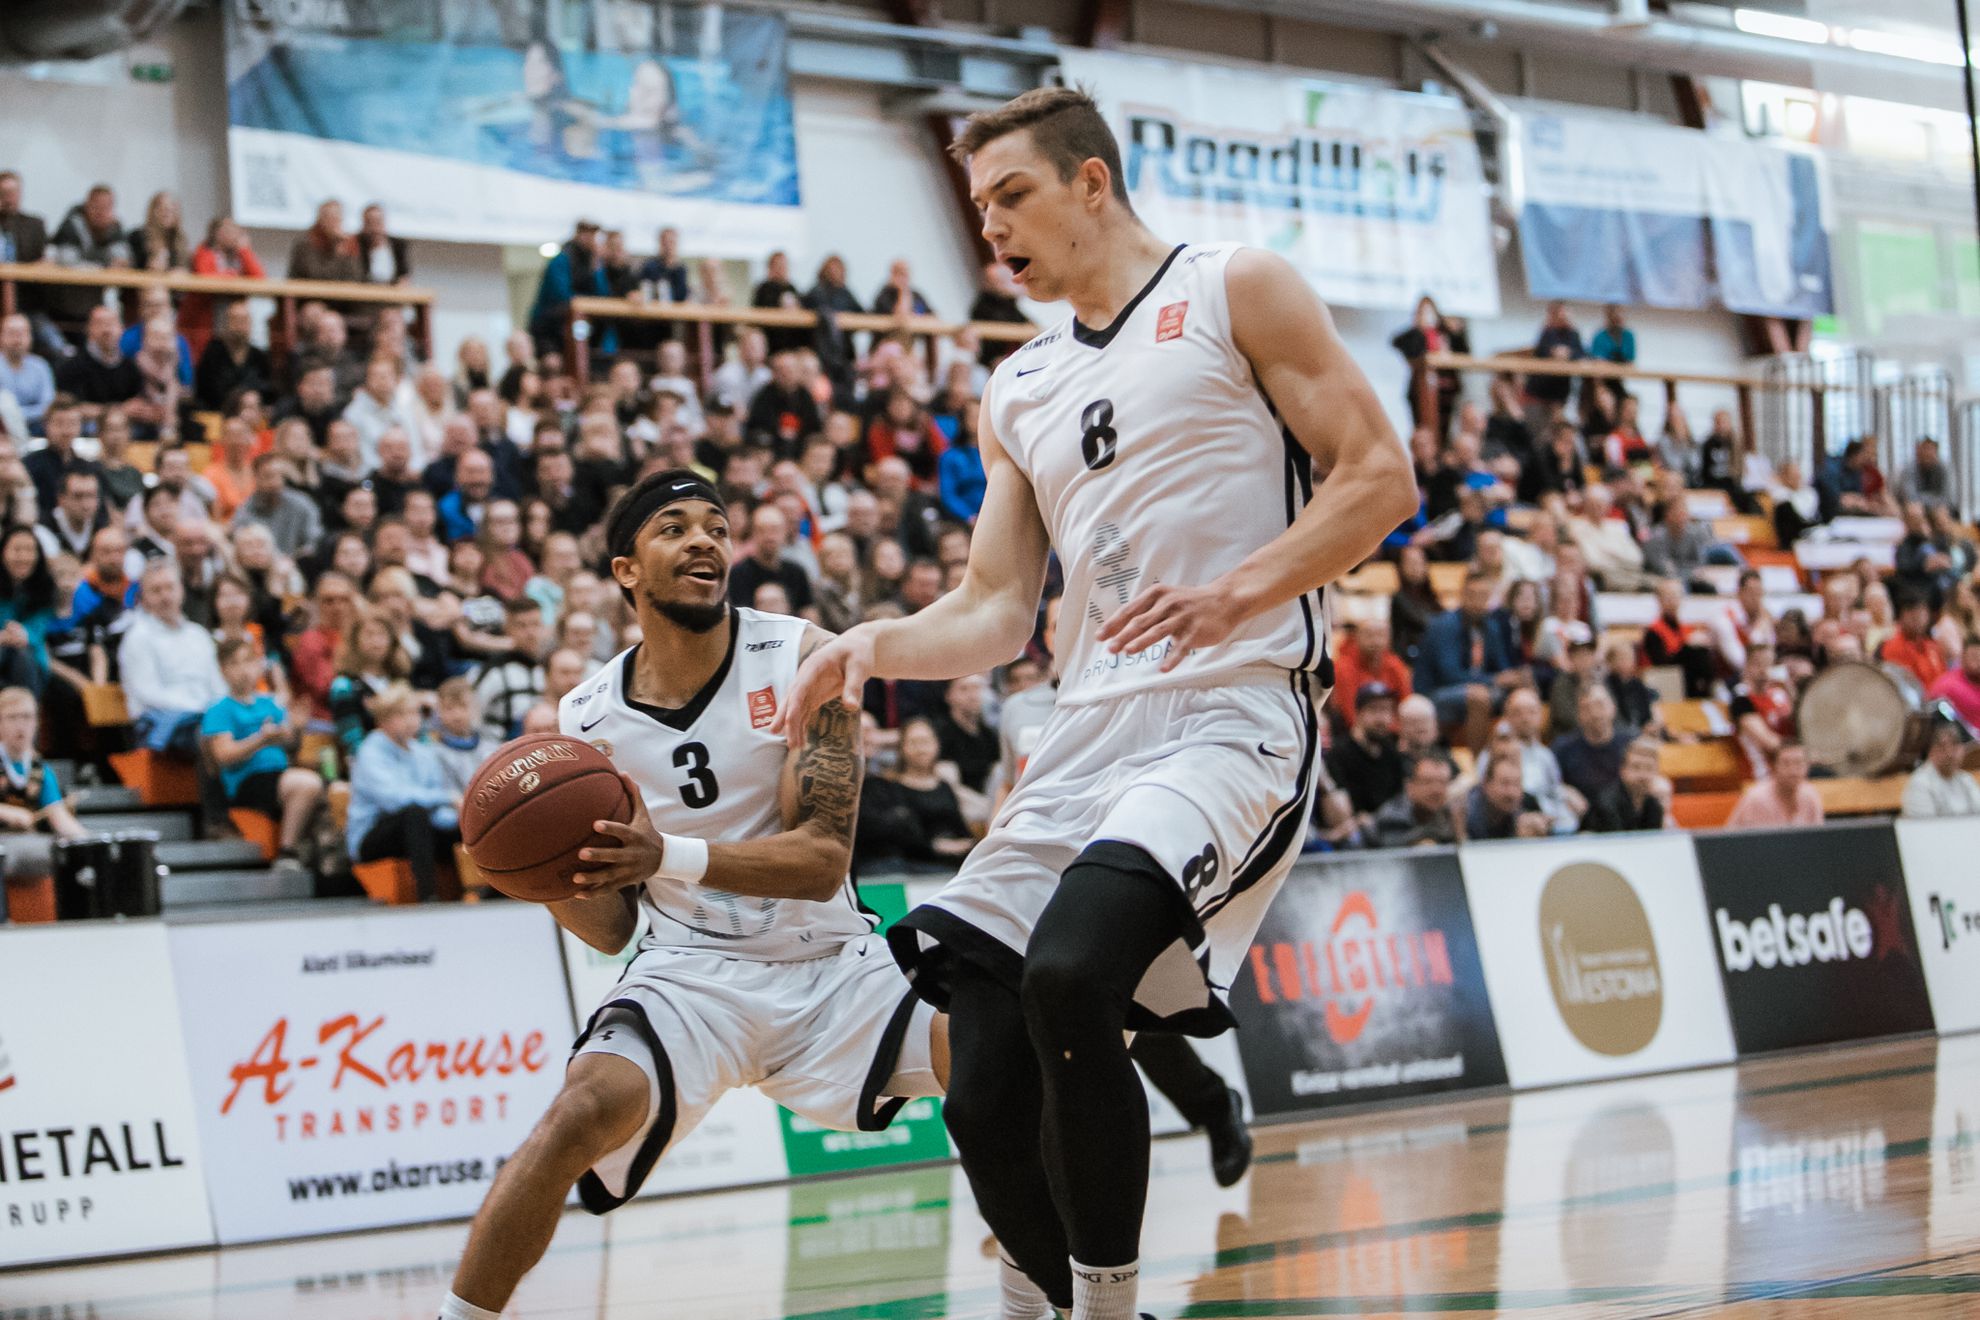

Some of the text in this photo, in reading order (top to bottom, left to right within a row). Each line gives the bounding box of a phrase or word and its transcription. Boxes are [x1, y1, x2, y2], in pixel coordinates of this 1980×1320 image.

[1081, 398, 1118, 471] 8
[672, 741, 719, 809] 3
[1182, 842, 1219, 904] 8
[1716, 896, 1872, 973] betsafe
[220, 1013, 547, 1116] A-Karuse
[274, 1093, 509, 1142] TRANSPORT
